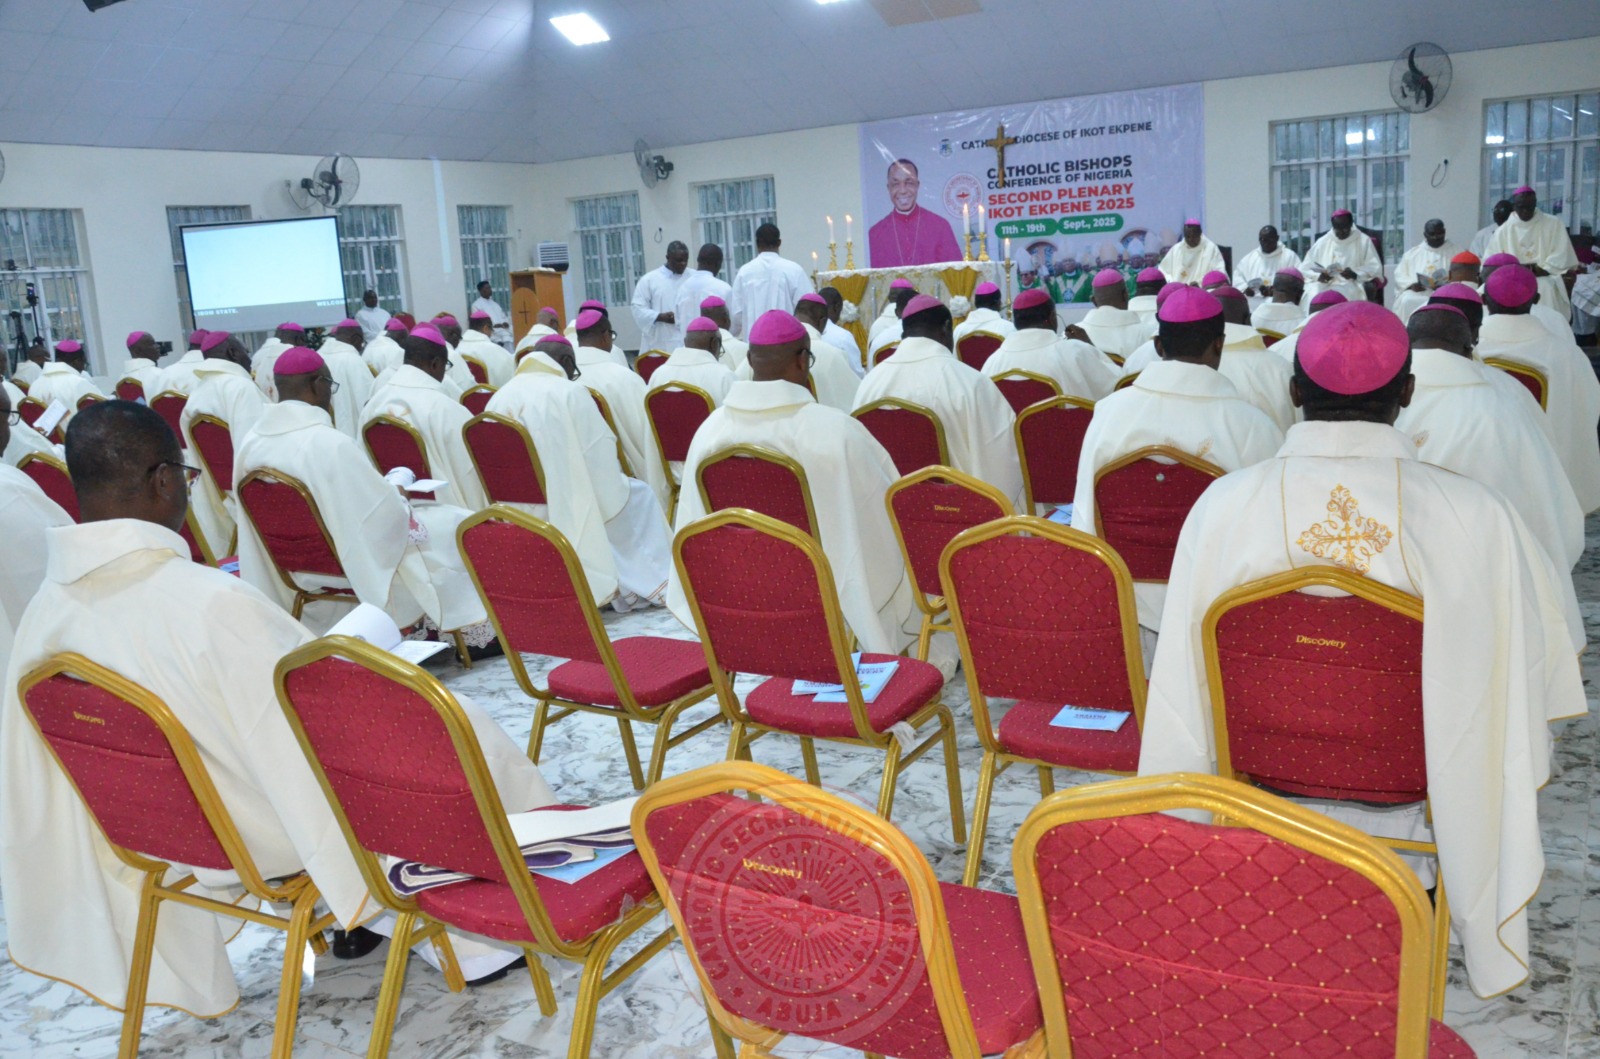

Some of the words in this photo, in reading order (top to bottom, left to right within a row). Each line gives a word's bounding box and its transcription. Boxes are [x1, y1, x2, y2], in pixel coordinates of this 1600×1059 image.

[961, 138, 989, 150] CATH
[1014, 131, 1060, 145] DIOCESE
[1062, 129, 1078, 139] OF
[1080, 126, 1106, 138] IKOT
[1108, 121, 1153, 135] EKPENE
[1064, 154, 1133, 173] BISHOPS
[987, 174, 1062, 190] CONFERENCE
[1065, 173, 1081, 183] OF
[1084, 168, 1133, 181] NIGERIA
[988, 189, 1053, 206] SECOND
[1057, 182, 1134, 200] PLENARY
[988, 205, 1024, 219] IKOT
[1028, 200, 1092, 217] EKPENE
[1096, 197, 1135, 211] 2025
[1001, 225, 1019, 235] 11th
[1026, 223, 1046, 233] 19th
[1093, 217, 1116, 228] 2025
